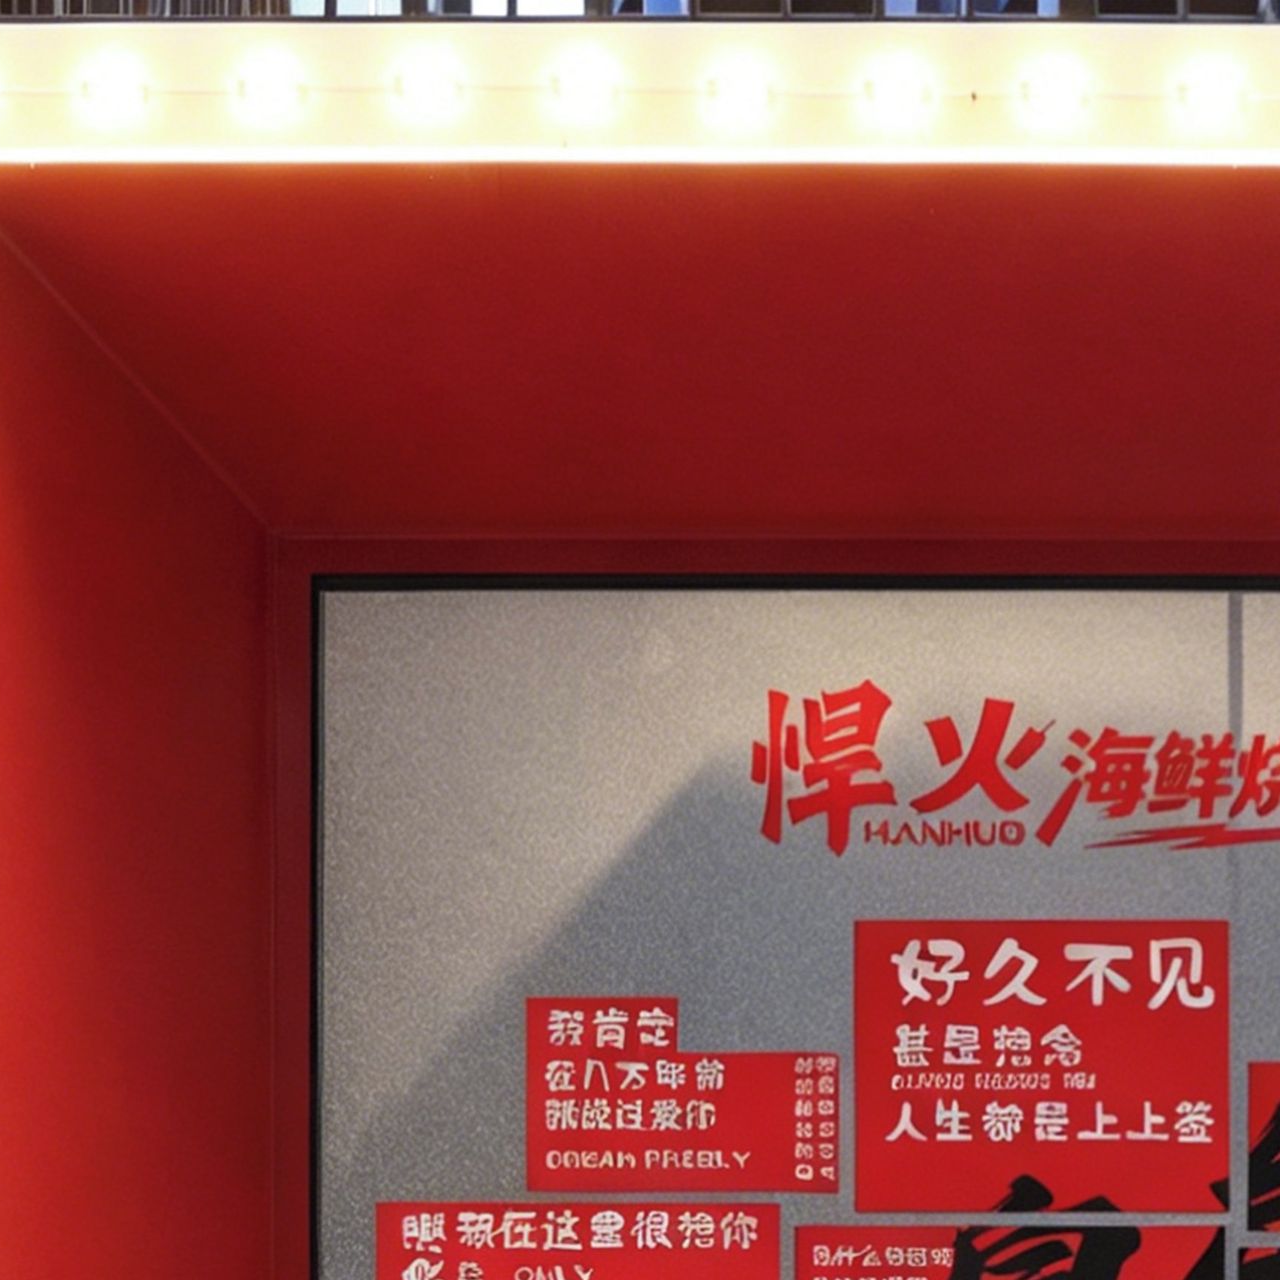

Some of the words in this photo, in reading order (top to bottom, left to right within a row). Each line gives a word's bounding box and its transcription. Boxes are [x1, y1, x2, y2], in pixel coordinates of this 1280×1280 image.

[865, 820, 1024, 846] HANHUO
[890, 937, 1215, 1010] 好久不见
[886, 1099, 1214, 1143] 人生都是上上签
